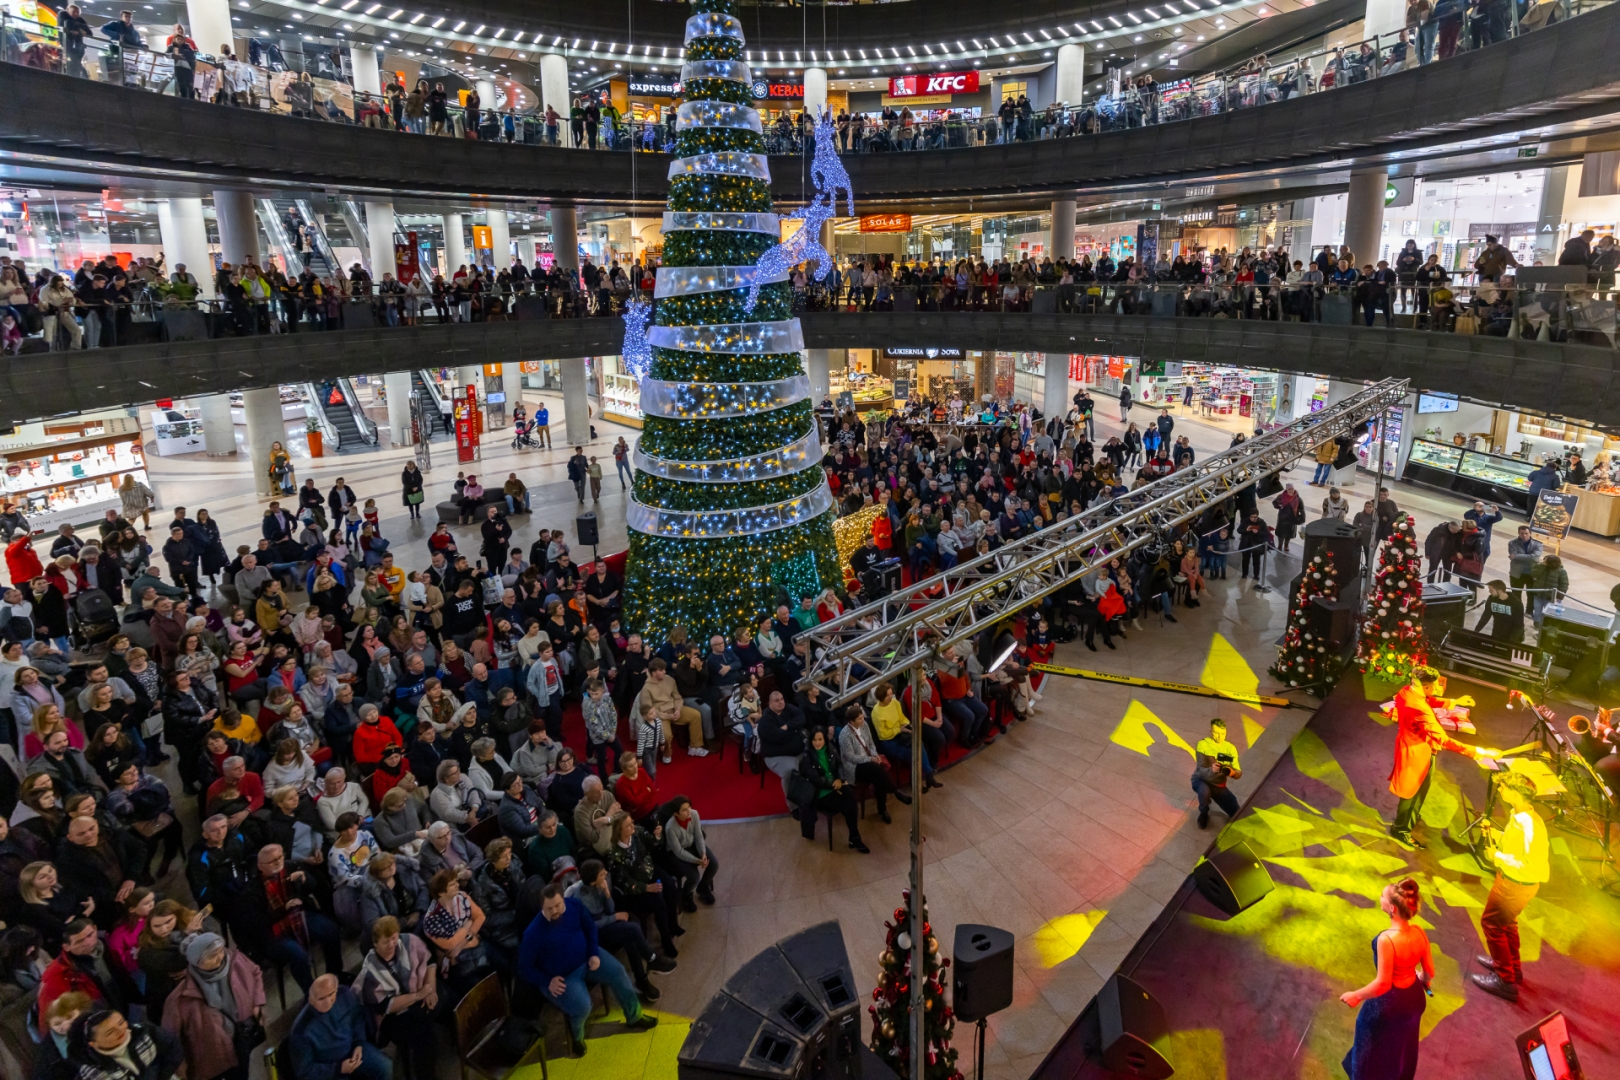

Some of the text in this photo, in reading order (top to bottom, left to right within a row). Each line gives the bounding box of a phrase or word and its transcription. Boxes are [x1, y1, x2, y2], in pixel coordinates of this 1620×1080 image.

[630, 83, 672, 93] express
[926, 75, 966, 92] KFC
[1184, 211, 1213, 222] MEDICINE
[869, 218, 901, 226] SOLAR
[887, 347, 924, 355] CUKIERNIA
[1096, 672, 1130, 681] KOMAN
[1162, 682, 1199, 691] KOMAN
